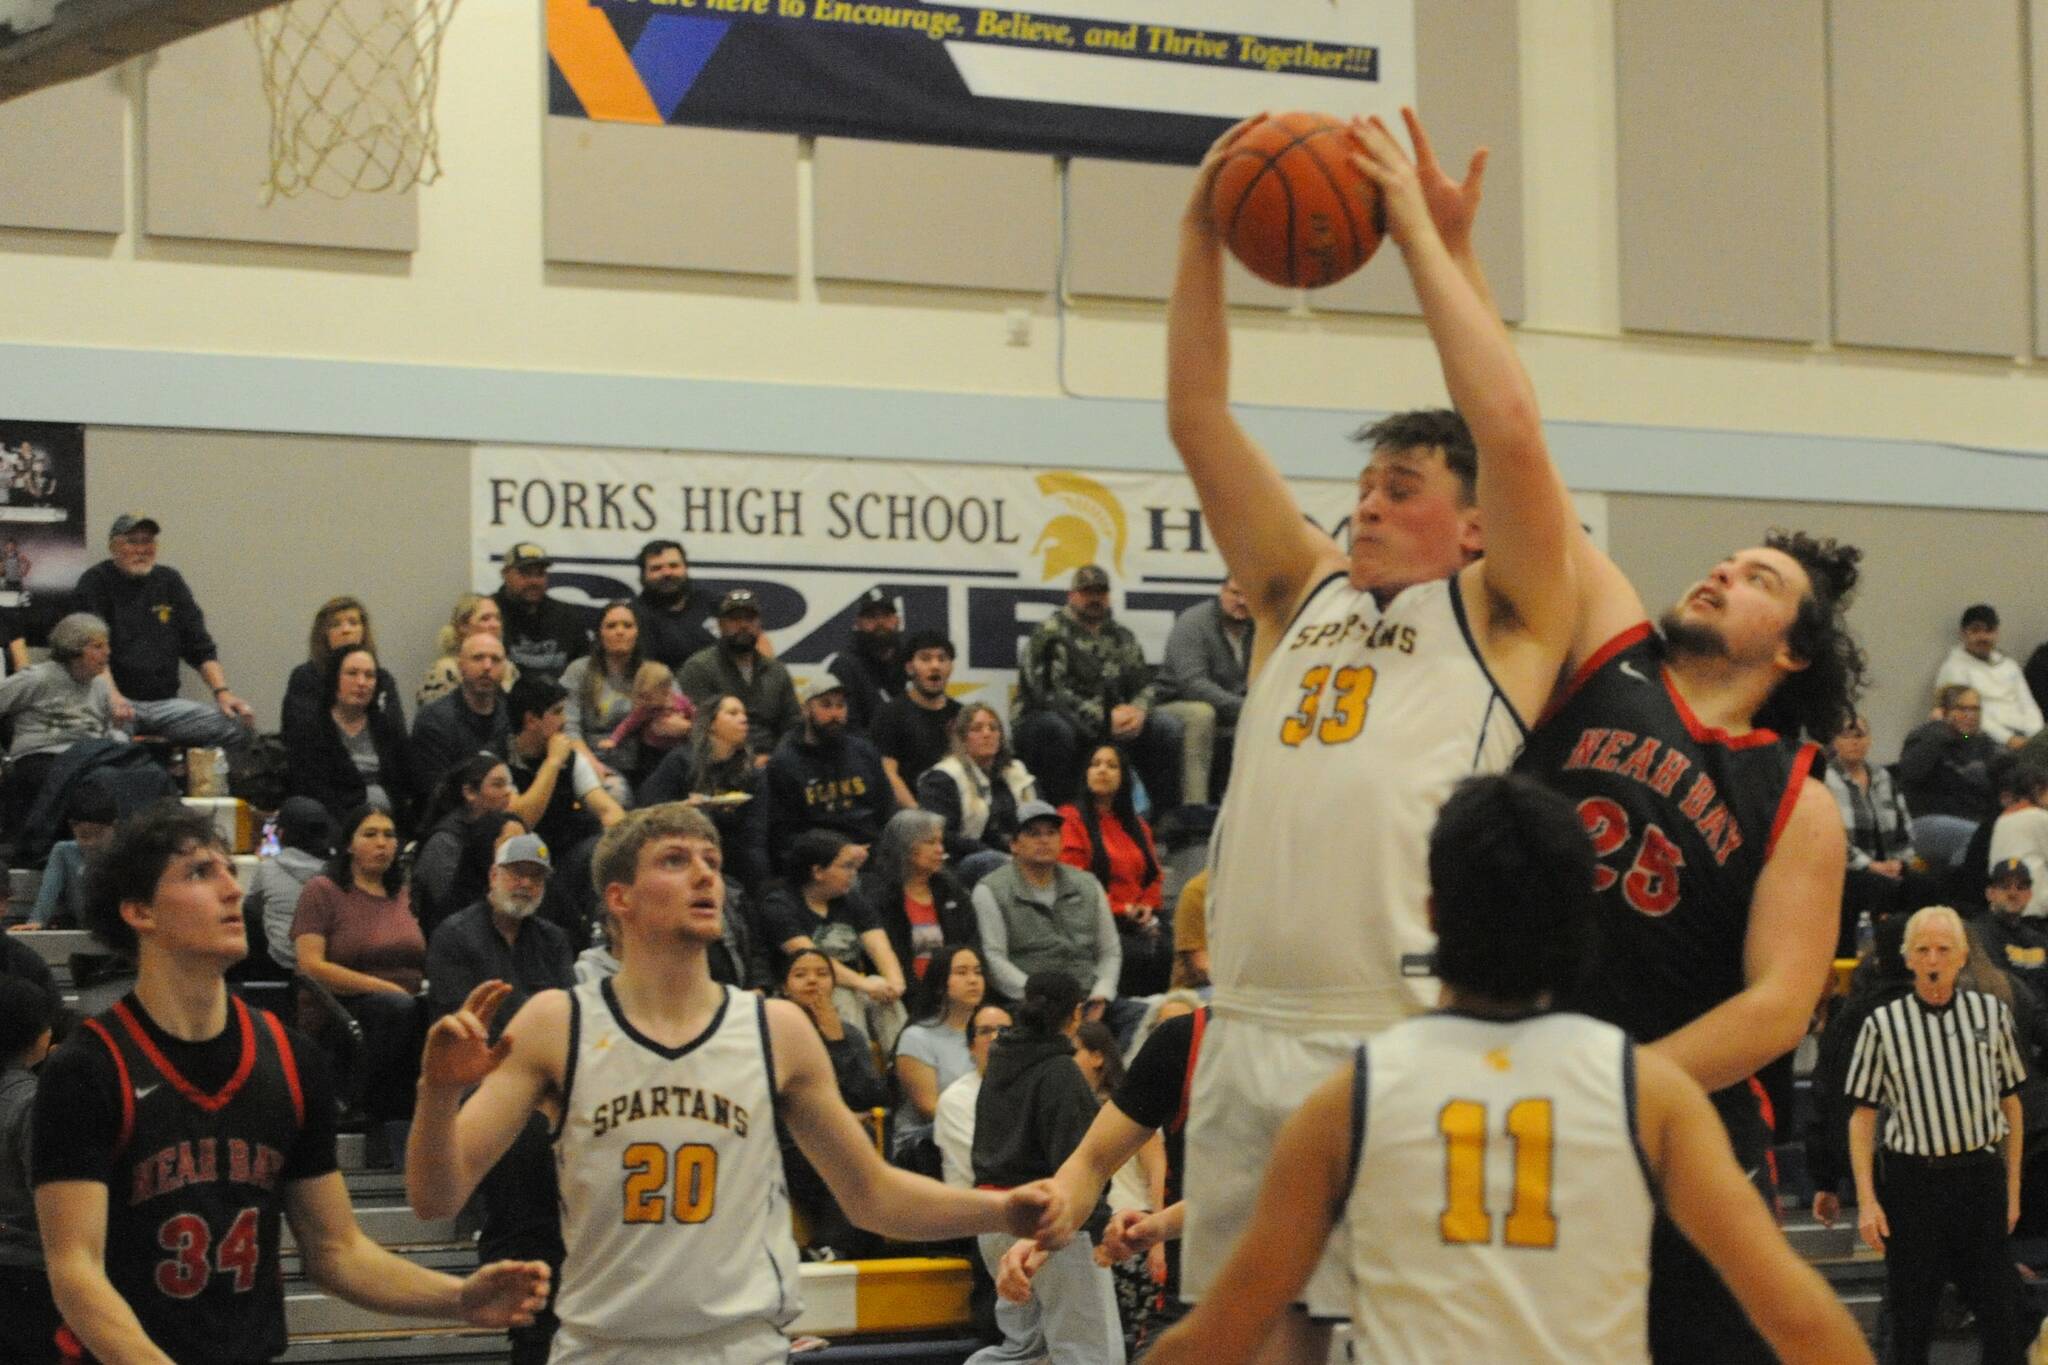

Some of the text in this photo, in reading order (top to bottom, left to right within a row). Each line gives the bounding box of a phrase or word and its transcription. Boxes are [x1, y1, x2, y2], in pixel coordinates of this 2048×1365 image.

[778, 0, 806, 19] to
[813, 0, 964, 39] Encourage,
[976, 9, 1075, 47] Believe,
[1083, 25, 1138, 50] and
[1146, 25, 1230, 59] Thrive
[1238, 35, 1372, 73] Together!!!
[489, 479, 1019, 544] FORKS HIGH SCHOOL
[1290, 614, 1416, 654] SPRNS
[1280, 664, 1377, 747] 33
[1562, 727, 1744, 866] NEAH BAY
[1576, 796, 1687, 916] 25
[593, 1086, 749, 1138] SPARTANS
[622, 1142, 718, 1224] 20
[1438, 1097, 1559, 1248] 11
[156, 1207, 261, 1299] 34
